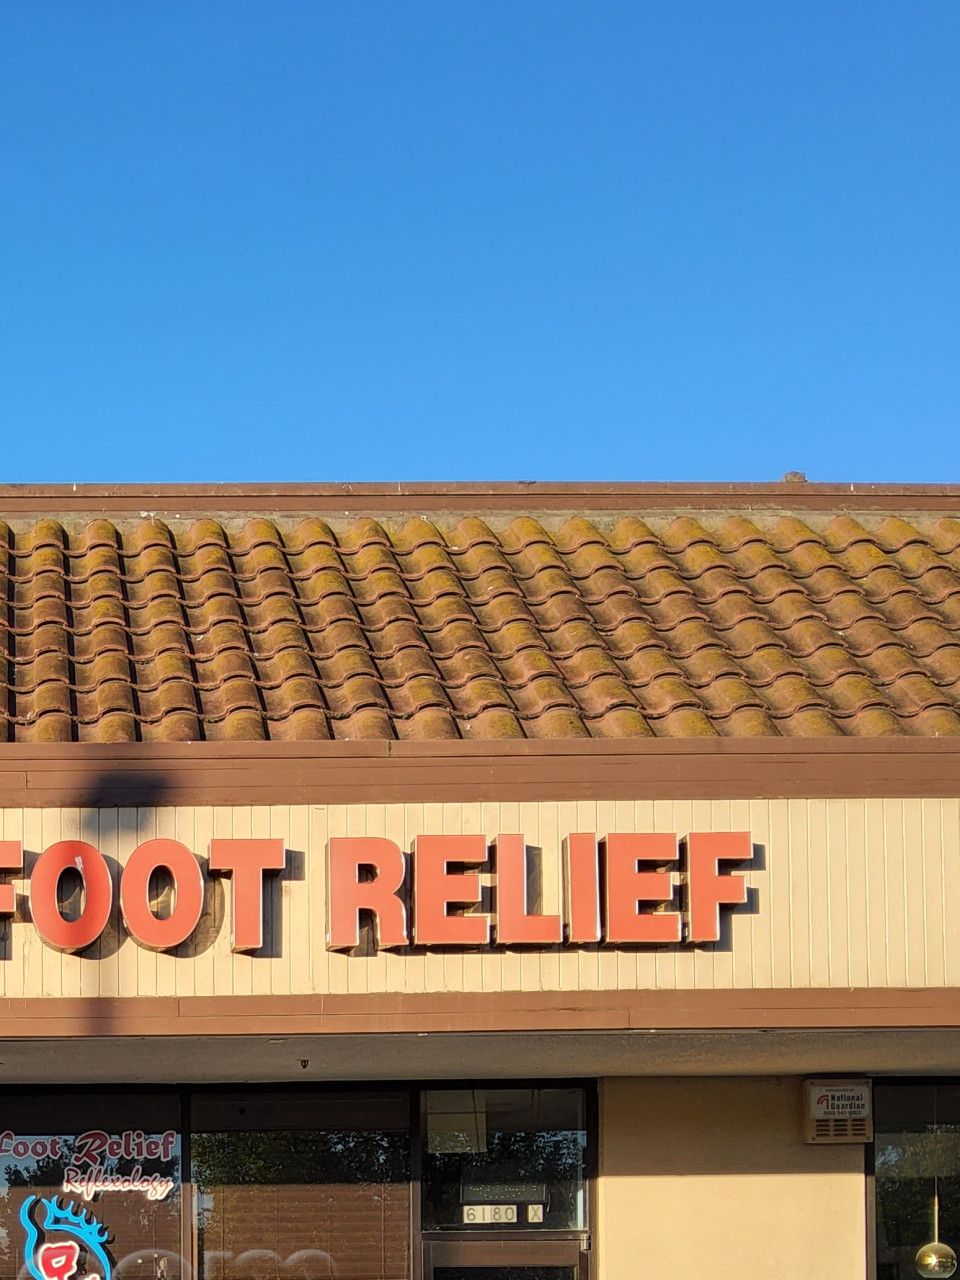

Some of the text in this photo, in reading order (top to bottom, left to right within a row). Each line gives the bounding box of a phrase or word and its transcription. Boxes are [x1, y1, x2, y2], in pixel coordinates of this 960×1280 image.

[326, 831, 753, 952] RELIEF
[74, 1130, 177, 1167] Relief
[64, 1167, 175, 1200] Reflexology
[466, 1206, 542, 1222] 6180 X
